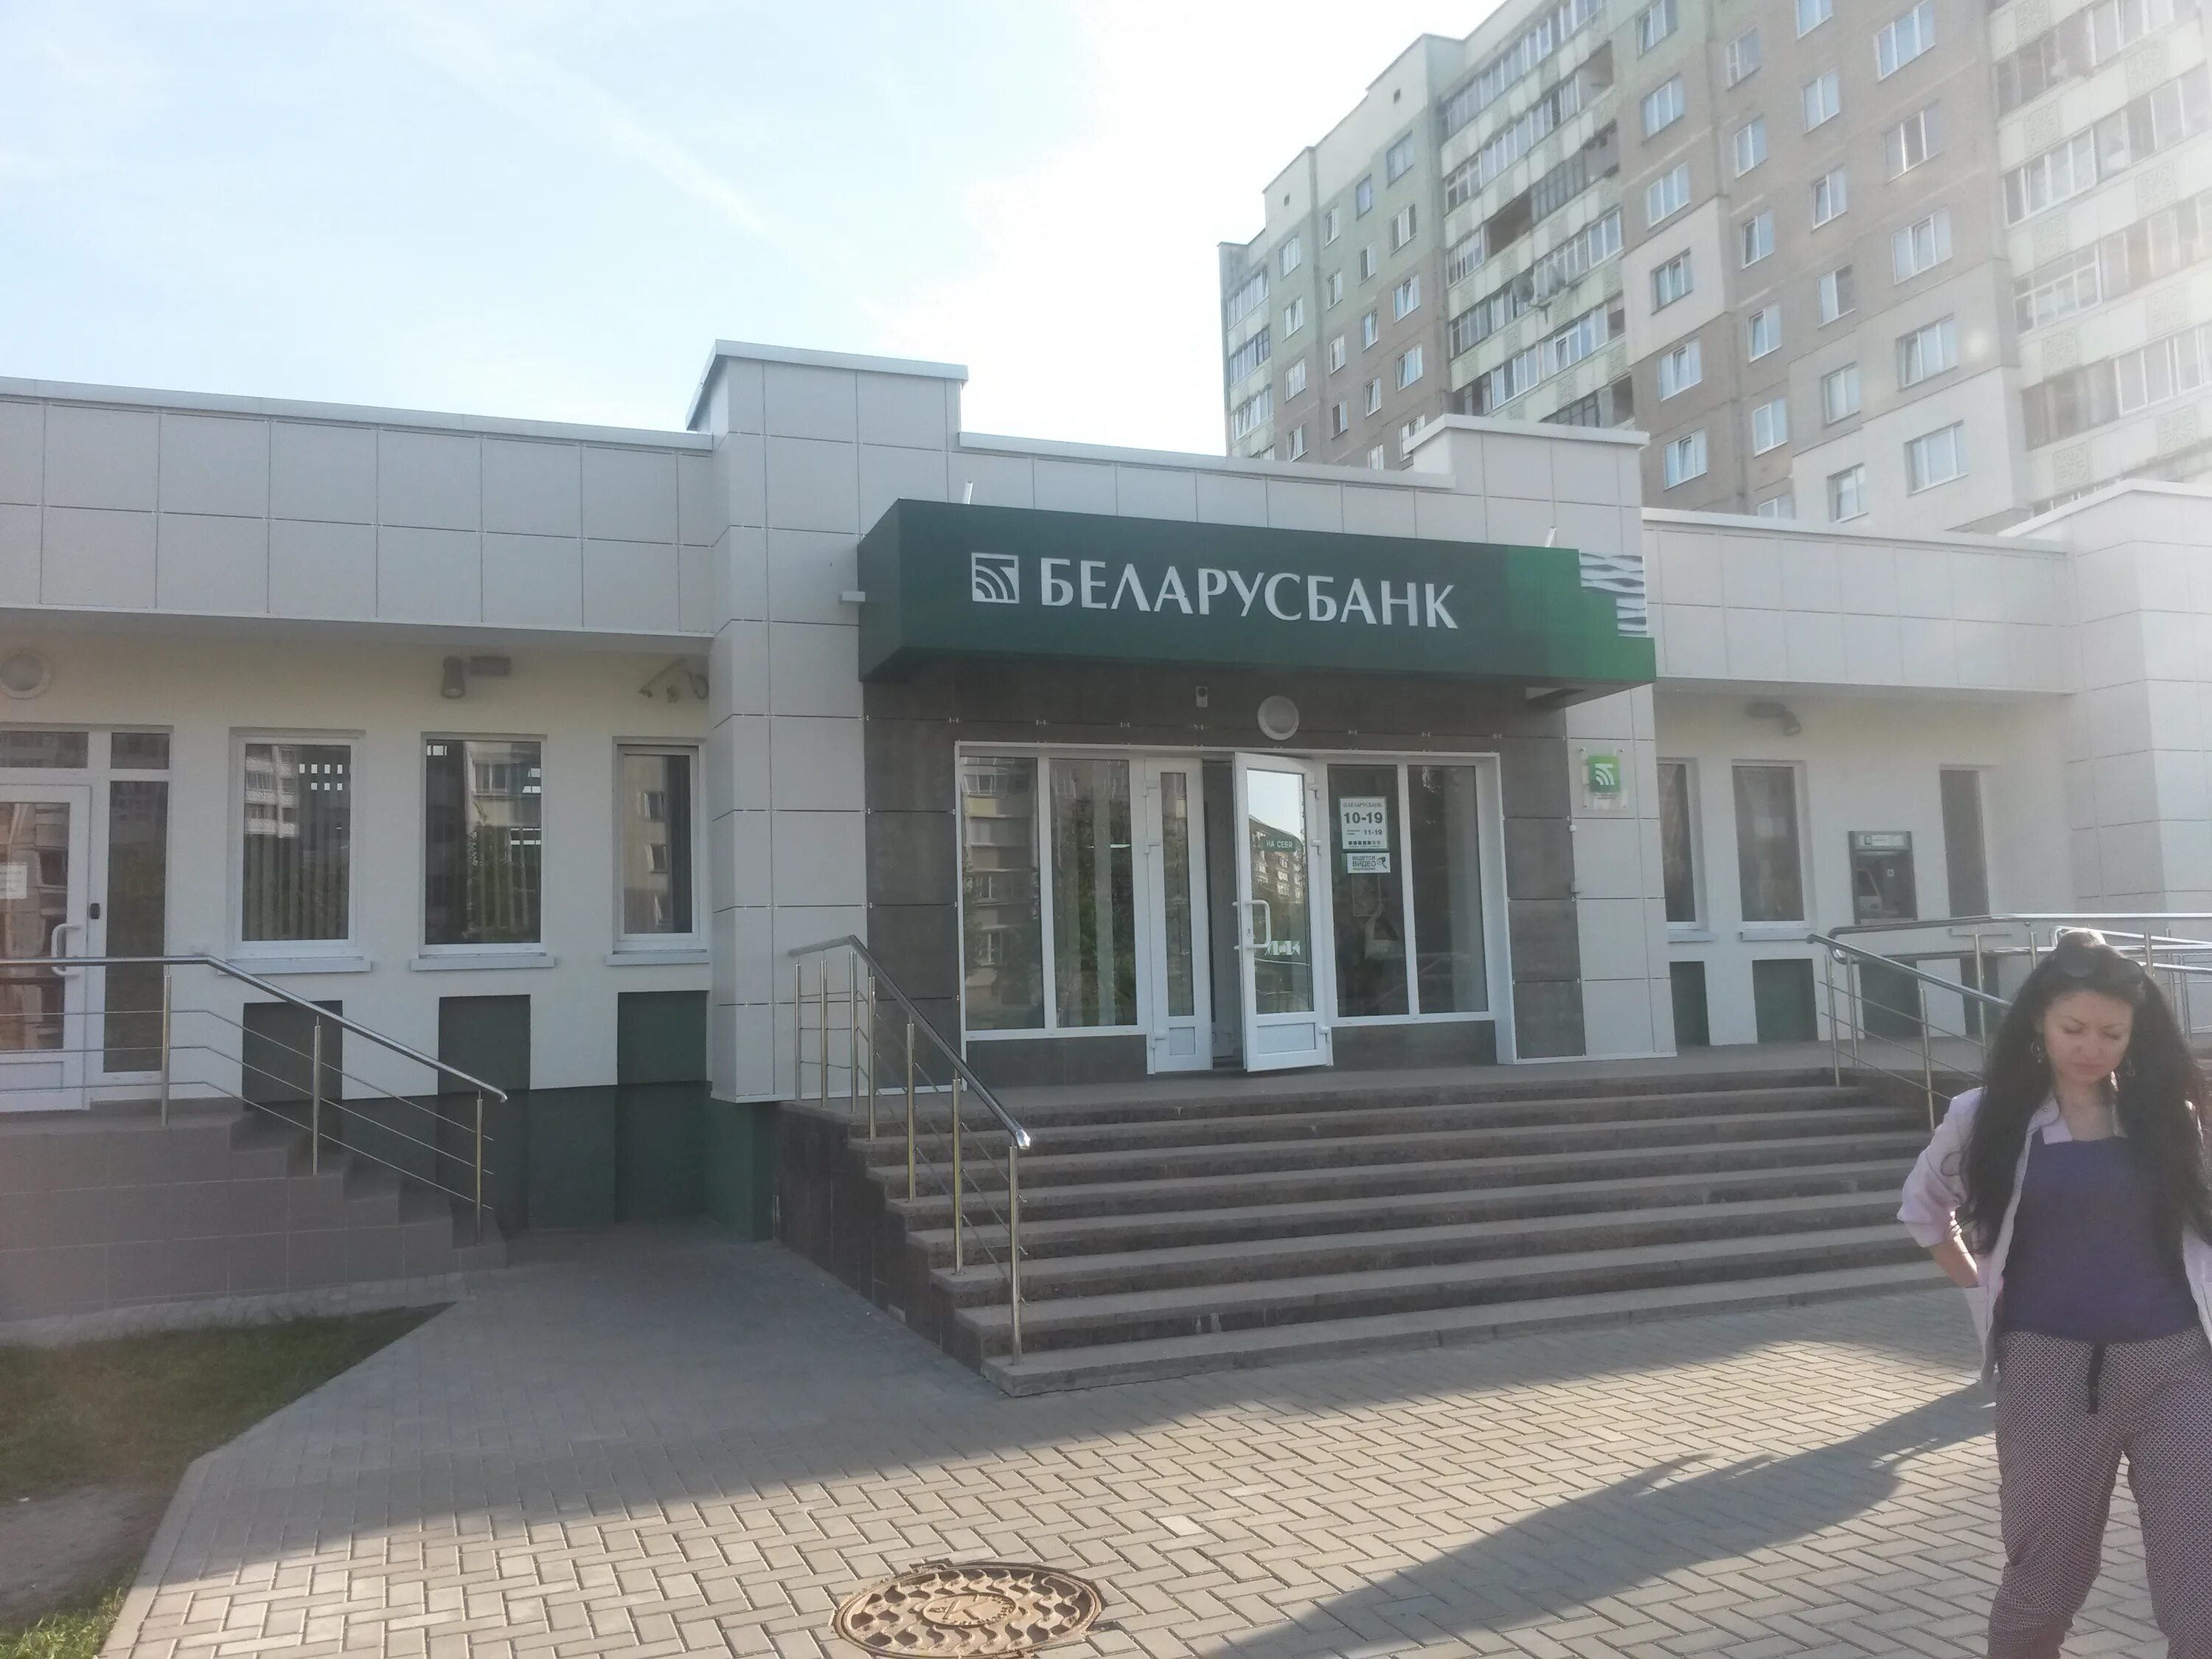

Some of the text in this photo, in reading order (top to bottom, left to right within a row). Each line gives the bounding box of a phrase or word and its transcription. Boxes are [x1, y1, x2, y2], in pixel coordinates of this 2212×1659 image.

[1040, 557, 1458, 629] БЕЛАРУСБАНК
[1343, 812, 1382, 824] 10-19
[1266, 840, 1293, 849] НА СЕБЯ
